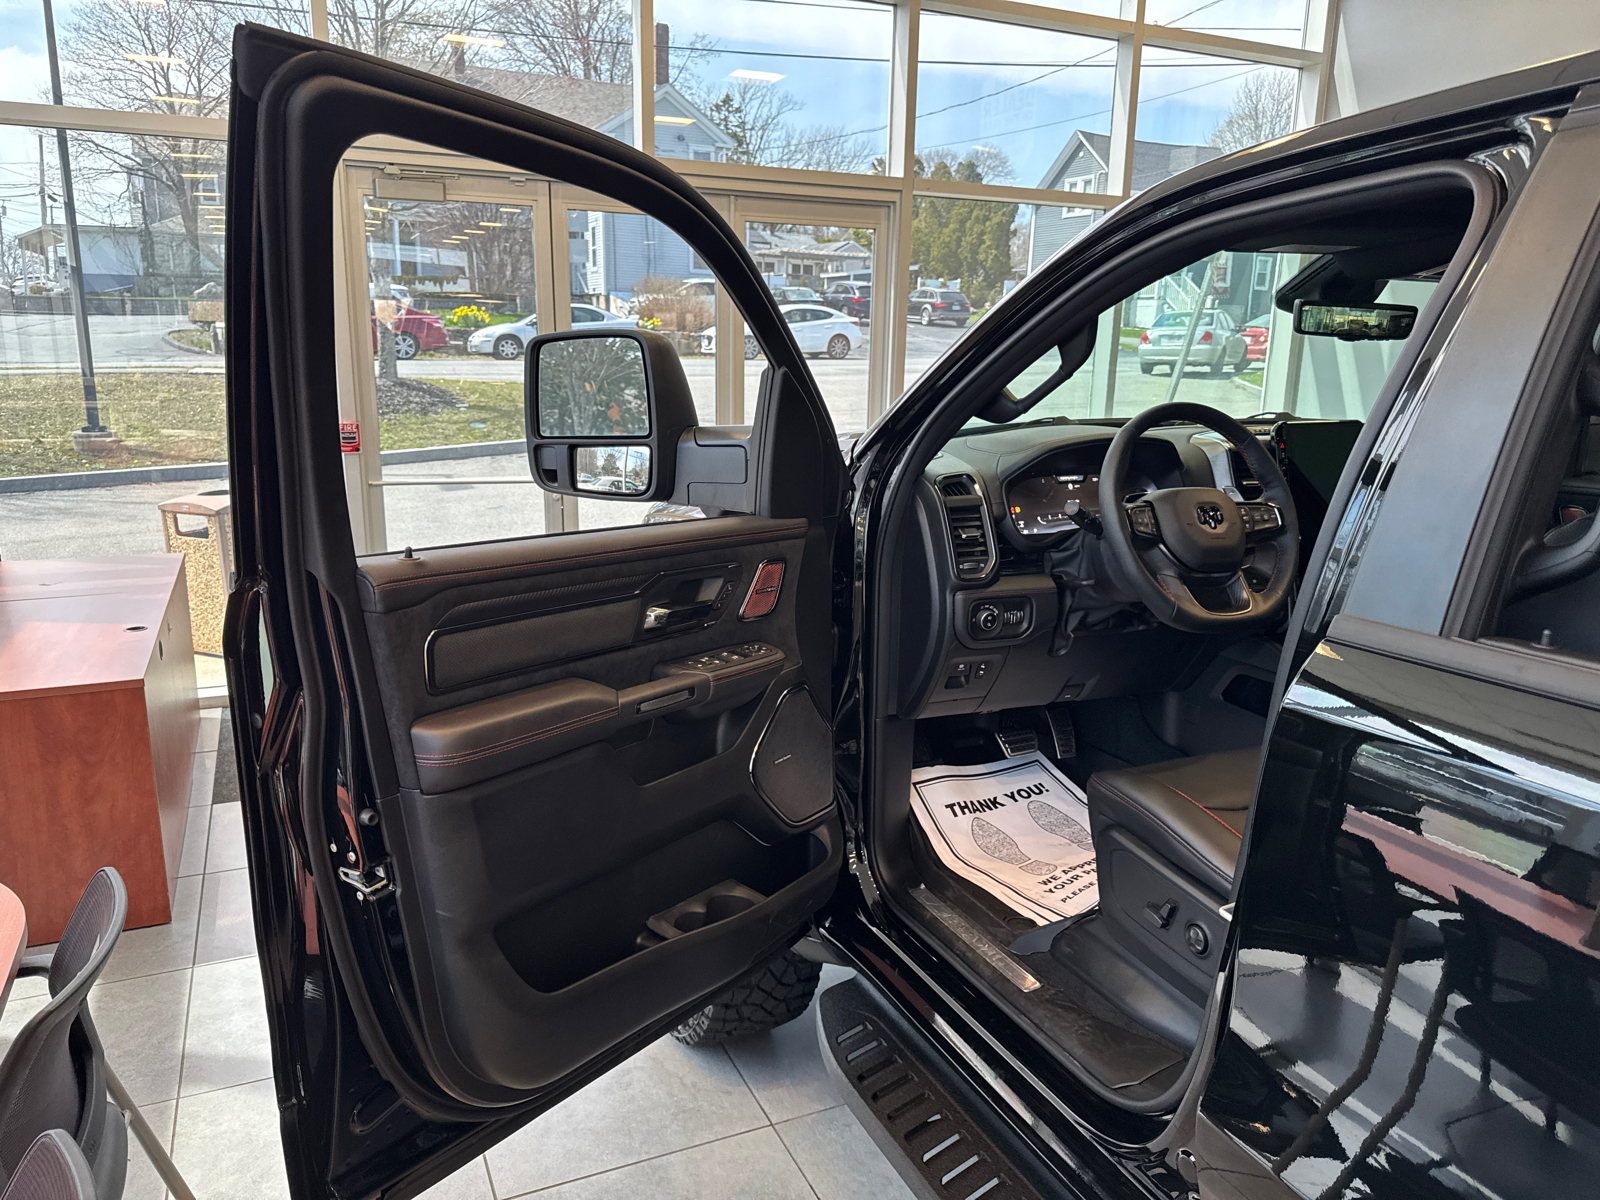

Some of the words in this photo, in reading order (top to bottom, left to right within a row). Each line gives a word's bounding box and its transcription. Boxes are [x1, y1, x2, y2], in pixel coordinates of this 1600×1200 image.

[944, 796, 1007, 818] THANK
[1002, 782, 1050, 803] YOU!
[1038, 874, 1062, 886] WE
[1043, 874, 1084, 894] YOUR
[1081, 867, 1097, 875] PA
[1060, 880, 1097, 903] PLEASE
